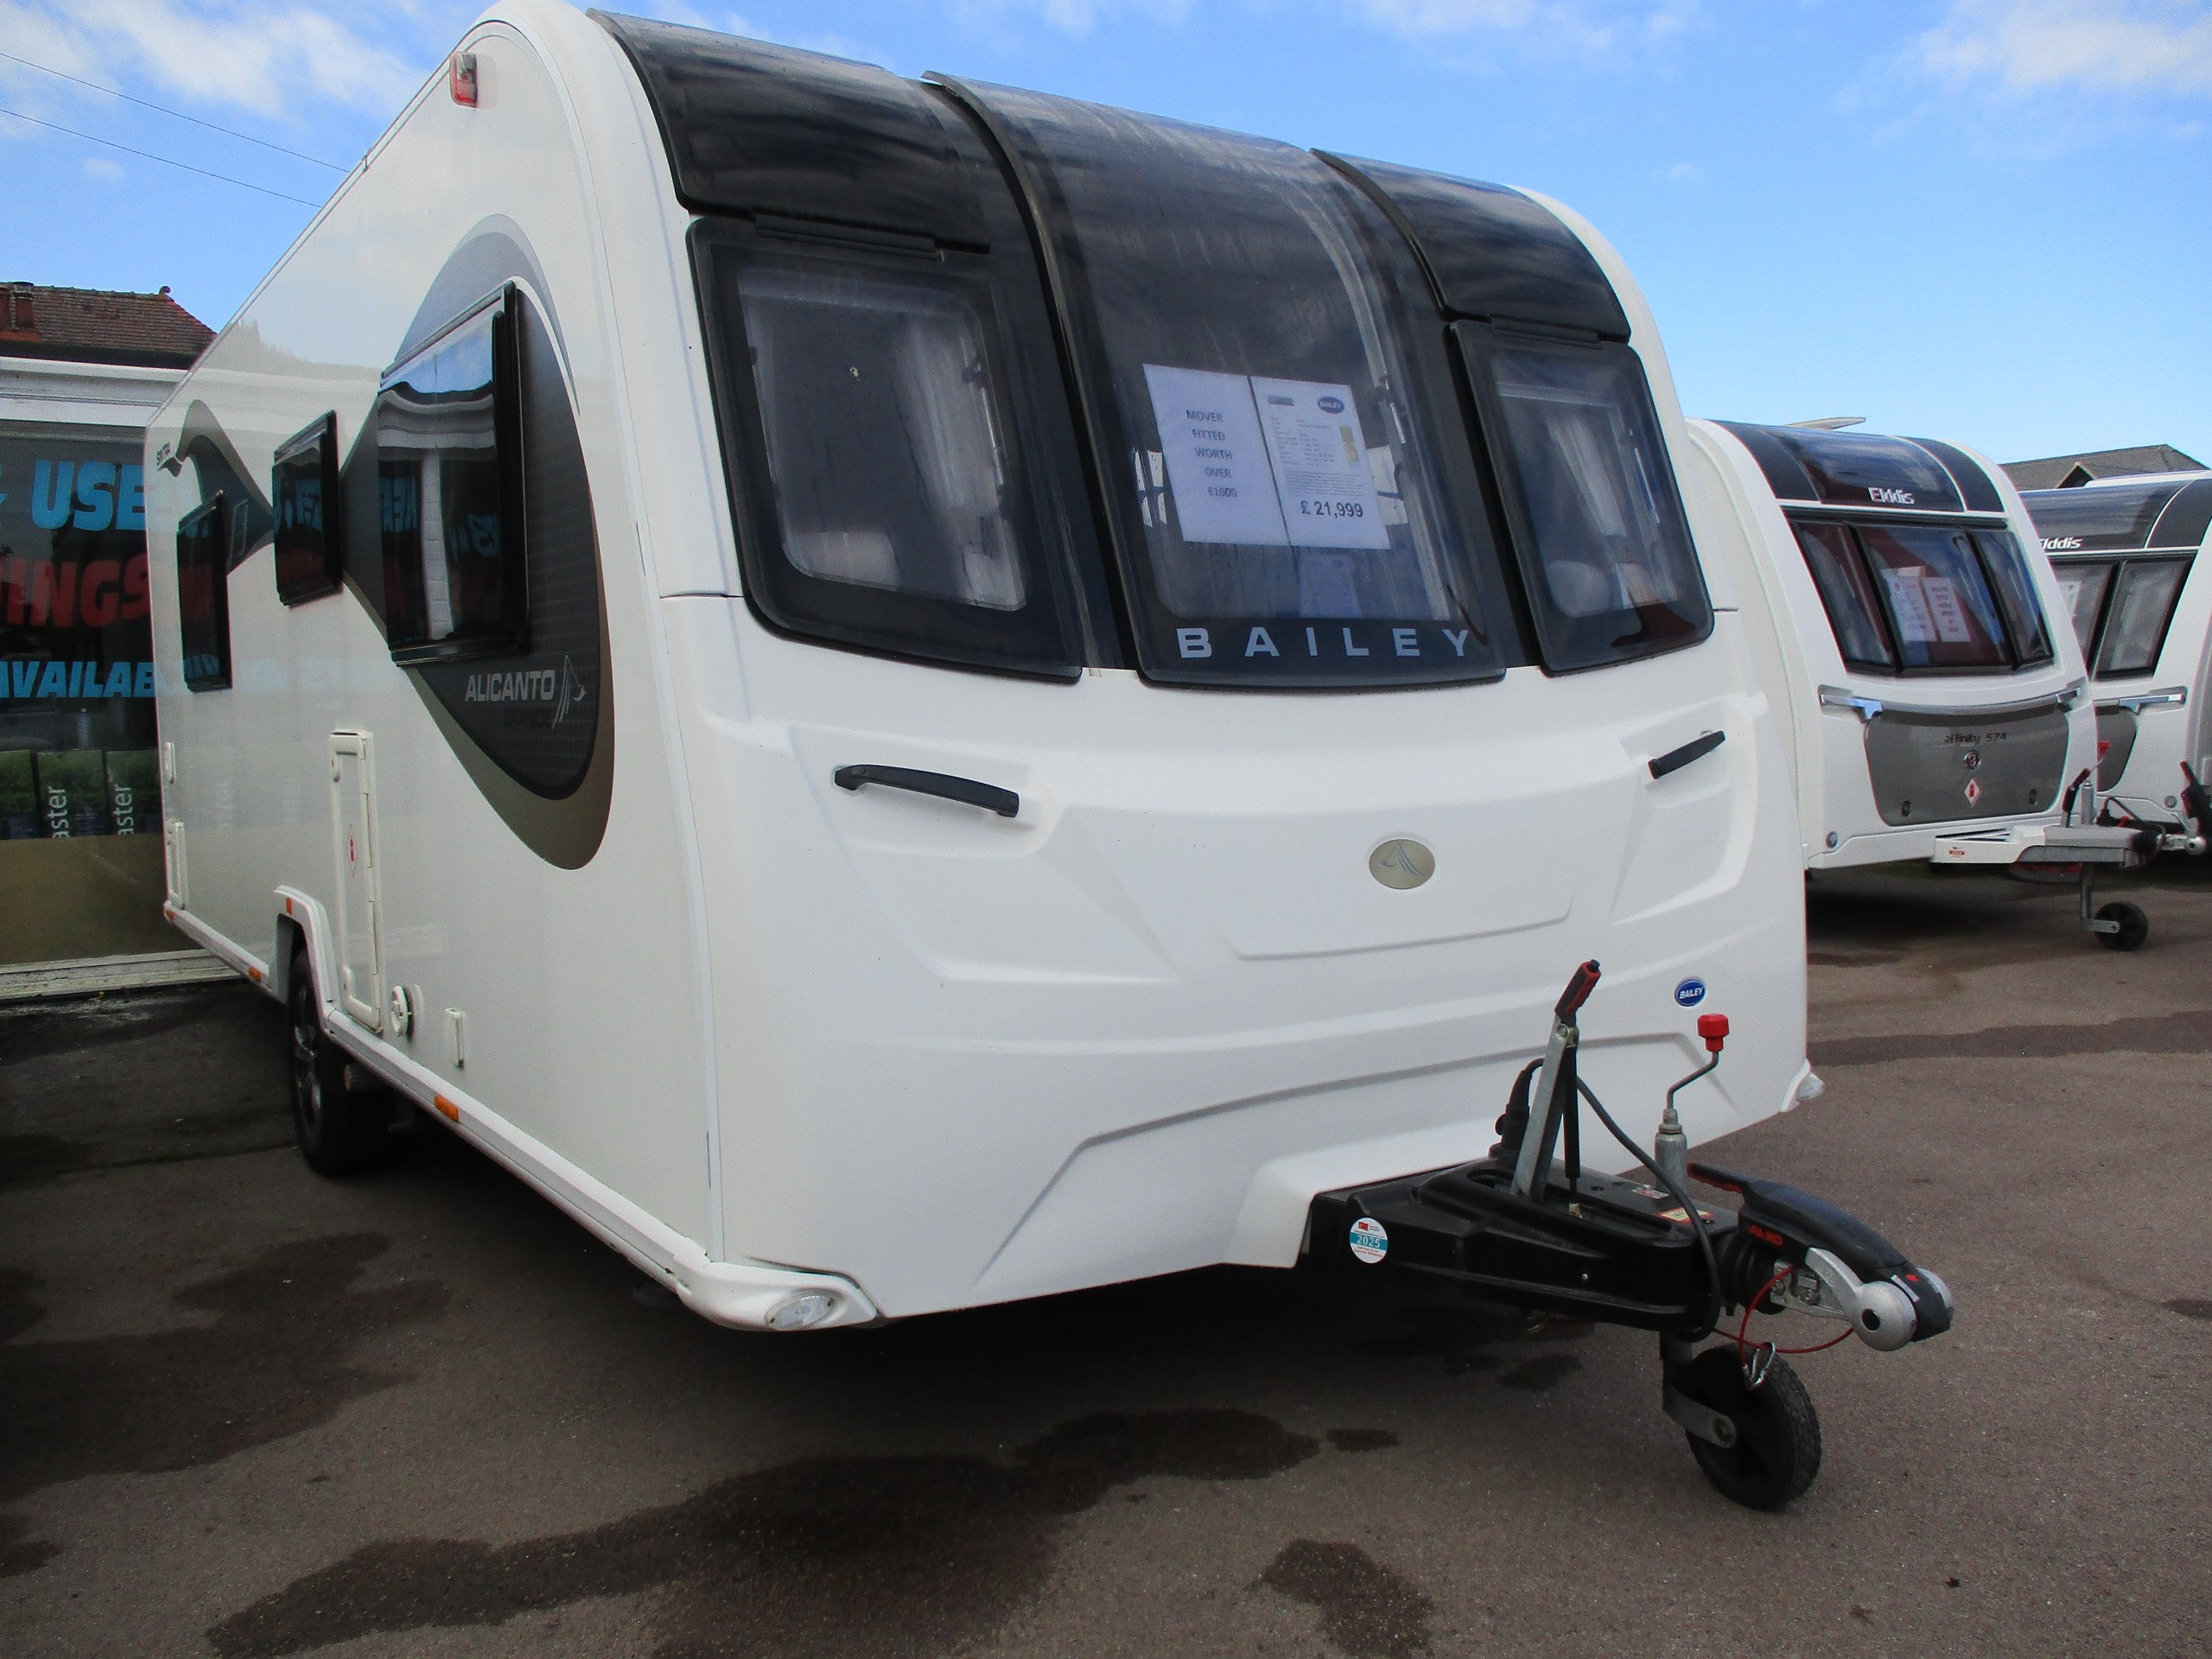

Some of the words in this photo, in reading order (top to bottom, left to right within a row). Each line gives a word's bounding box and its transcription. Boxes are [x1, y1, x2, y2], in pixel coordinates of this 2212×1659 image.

[1185, 410, 1224, 423] MOVER
[1192, 429, 1225, 442] FITTED
[1195, 447, 1232, 460] WORTH
[1205, 467, 1231, 478] OVER
[1208, 486, 1237, 498] £1000
[1867, 486, 1916, 505] Elddis
[1300, 500, 1311, 516] £
[1314, 500, 1363, 519] 21,999
[0, 546, 150, 628] INGS
[1176, 626, 1469, 658] BAILEY
[465, 669, 556, 702] ALICANTO
[1944, 733, 1981, 745] affinity
[1986, 732, 2007, 742] 574
[1679, 987, 1704, 1000] BAILEY
[1357, 1235, 1381, 1249] 2025
